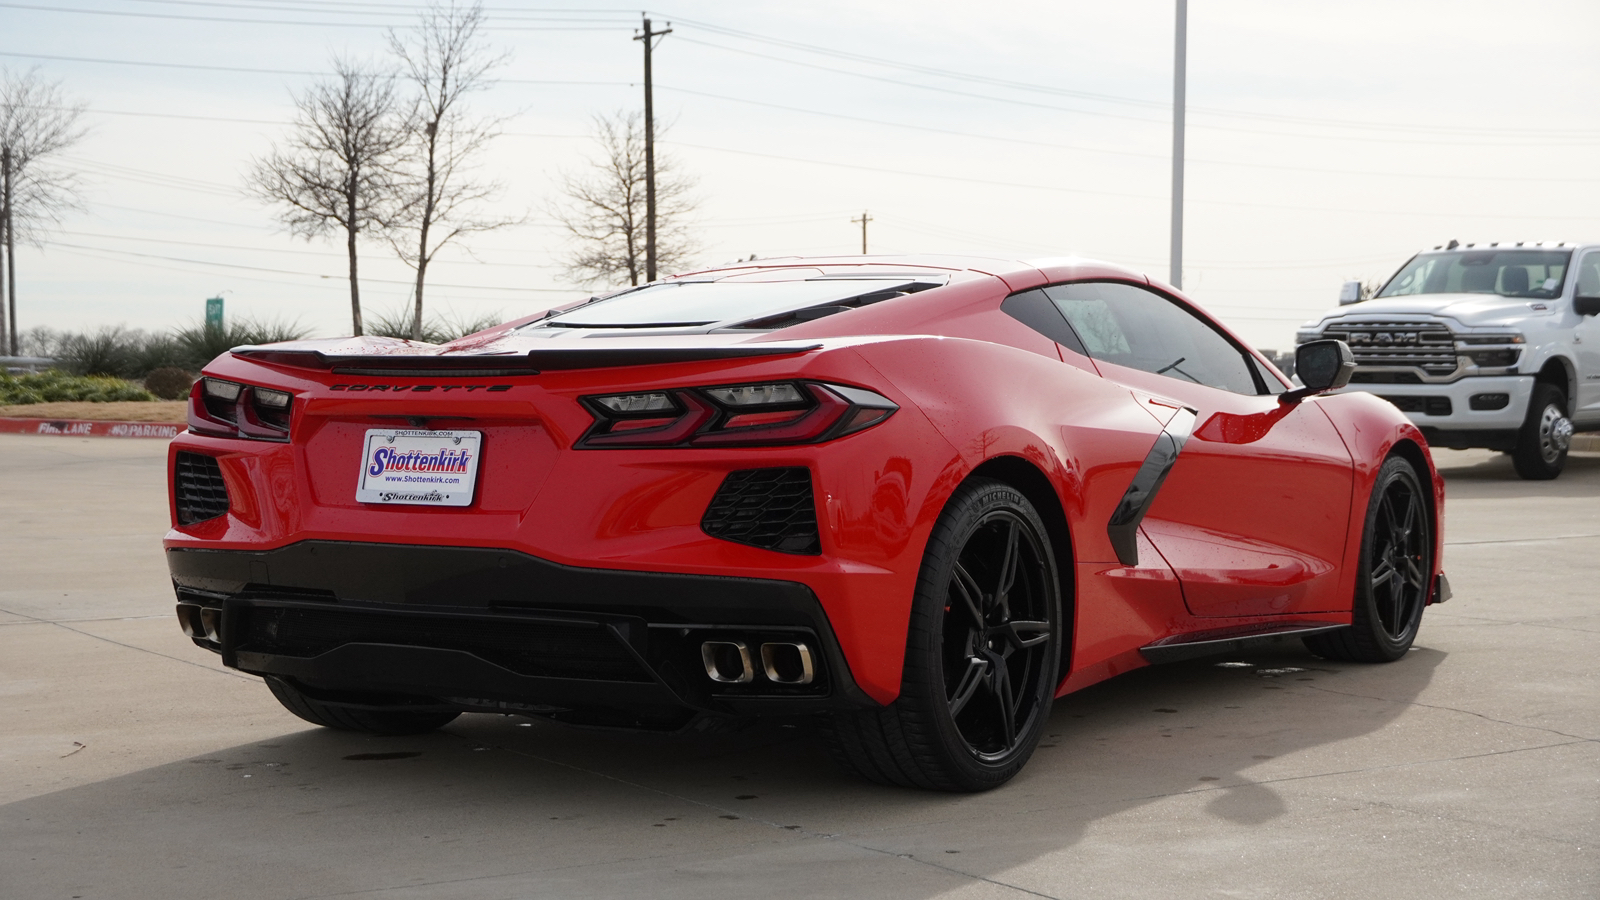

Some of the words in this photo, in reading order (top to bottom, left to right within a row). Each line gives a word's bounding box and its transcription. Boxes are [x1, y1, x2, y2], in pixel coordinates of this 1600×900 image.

[1350, 332, 1417, 343] RAM
[329, 384, 514, 392] CORVETTE
[63, 423, 93, 435] LANE
[111, 424, 128, 435] NO
[129, 425, 177, 437] PARKING
[368, 446, 472, 477] Shottenkirk
[385, 475, 460, 484] www.Shottenkirk.com
[382, 491, 443, 502] Shottenkirk
[981, 491, 1020, 504] MICHELIN
